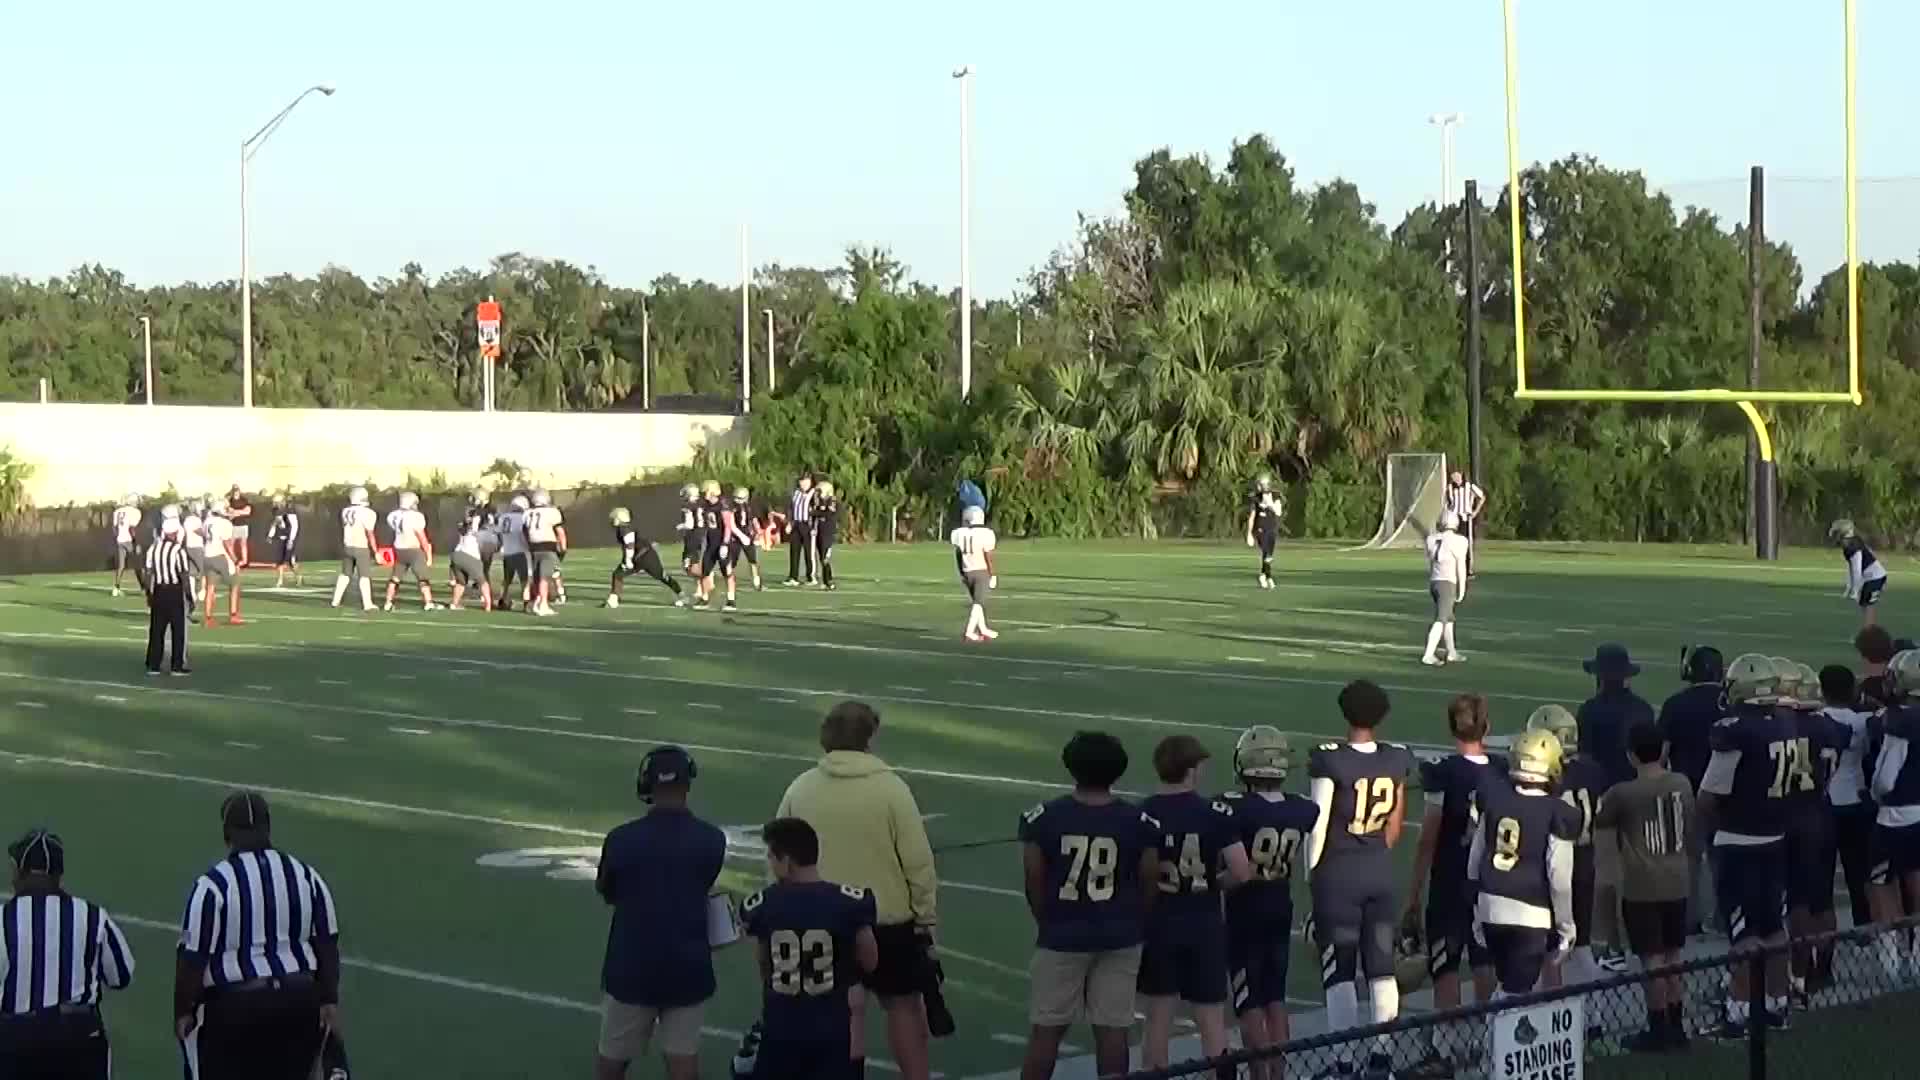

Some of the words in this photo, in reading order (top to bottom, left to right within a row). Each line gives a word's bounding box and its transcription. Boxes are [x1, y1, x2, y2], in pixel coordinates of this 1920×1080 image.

[1347, 777, 1395, 835] 12
[1058, 834, 1118, 901] 78
[770, 929, 834, 995] 83
[1552, 1009, 1572, 1034] NO
[1504, 1038, 1572, 1077] STANDING
